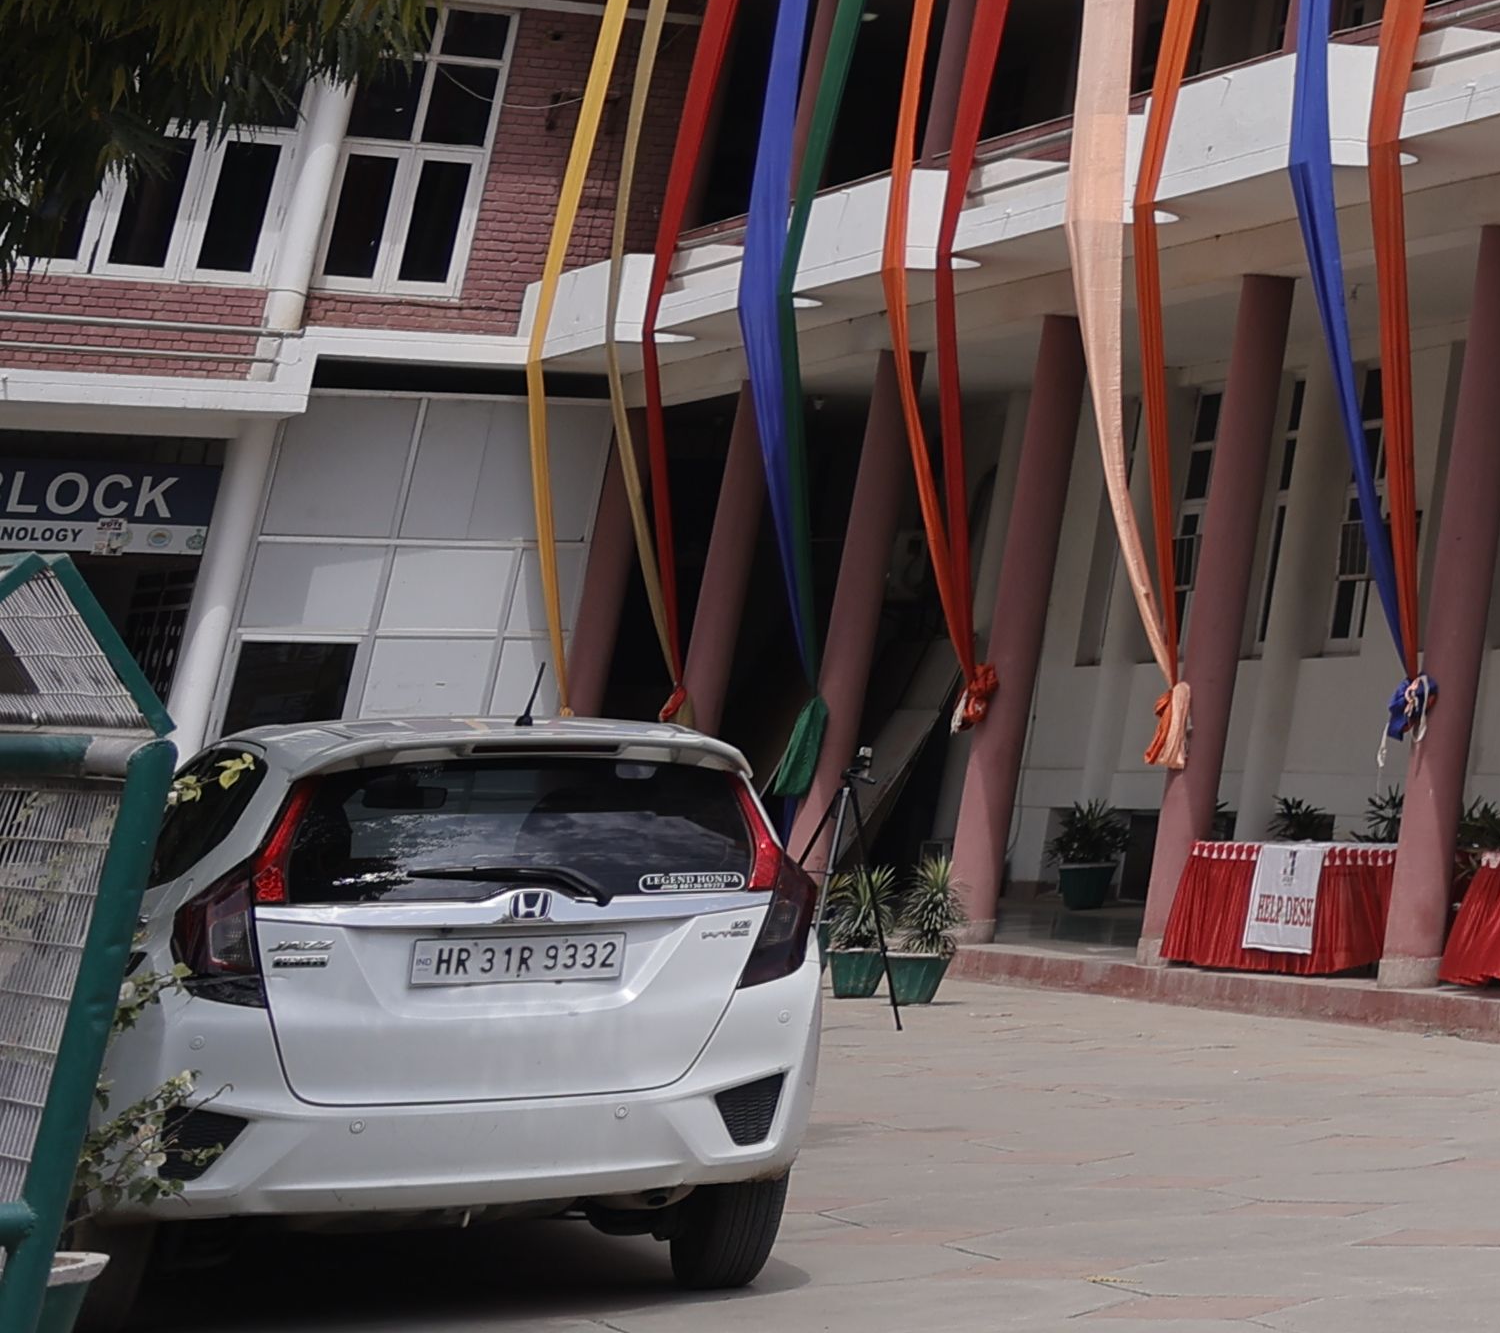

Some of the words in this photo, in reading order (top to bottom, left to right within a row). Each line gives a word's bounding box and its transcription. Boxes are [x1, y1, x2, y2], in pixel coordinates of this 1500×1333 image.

[0, 471, 179, 518] LOCK
[646, 875, 694, 885] LEGEND
[697, 874, 739, 883] HONDA
[1256, 894, 1284, 924] HELP
[1284, 896, 1314, 927] DESK
[267, 941, 336, 952] JAZZ
[416, 957, 431, 966] IND
[435, 947, 471, 975] HR
[543, 941, 617, 970] 9332
